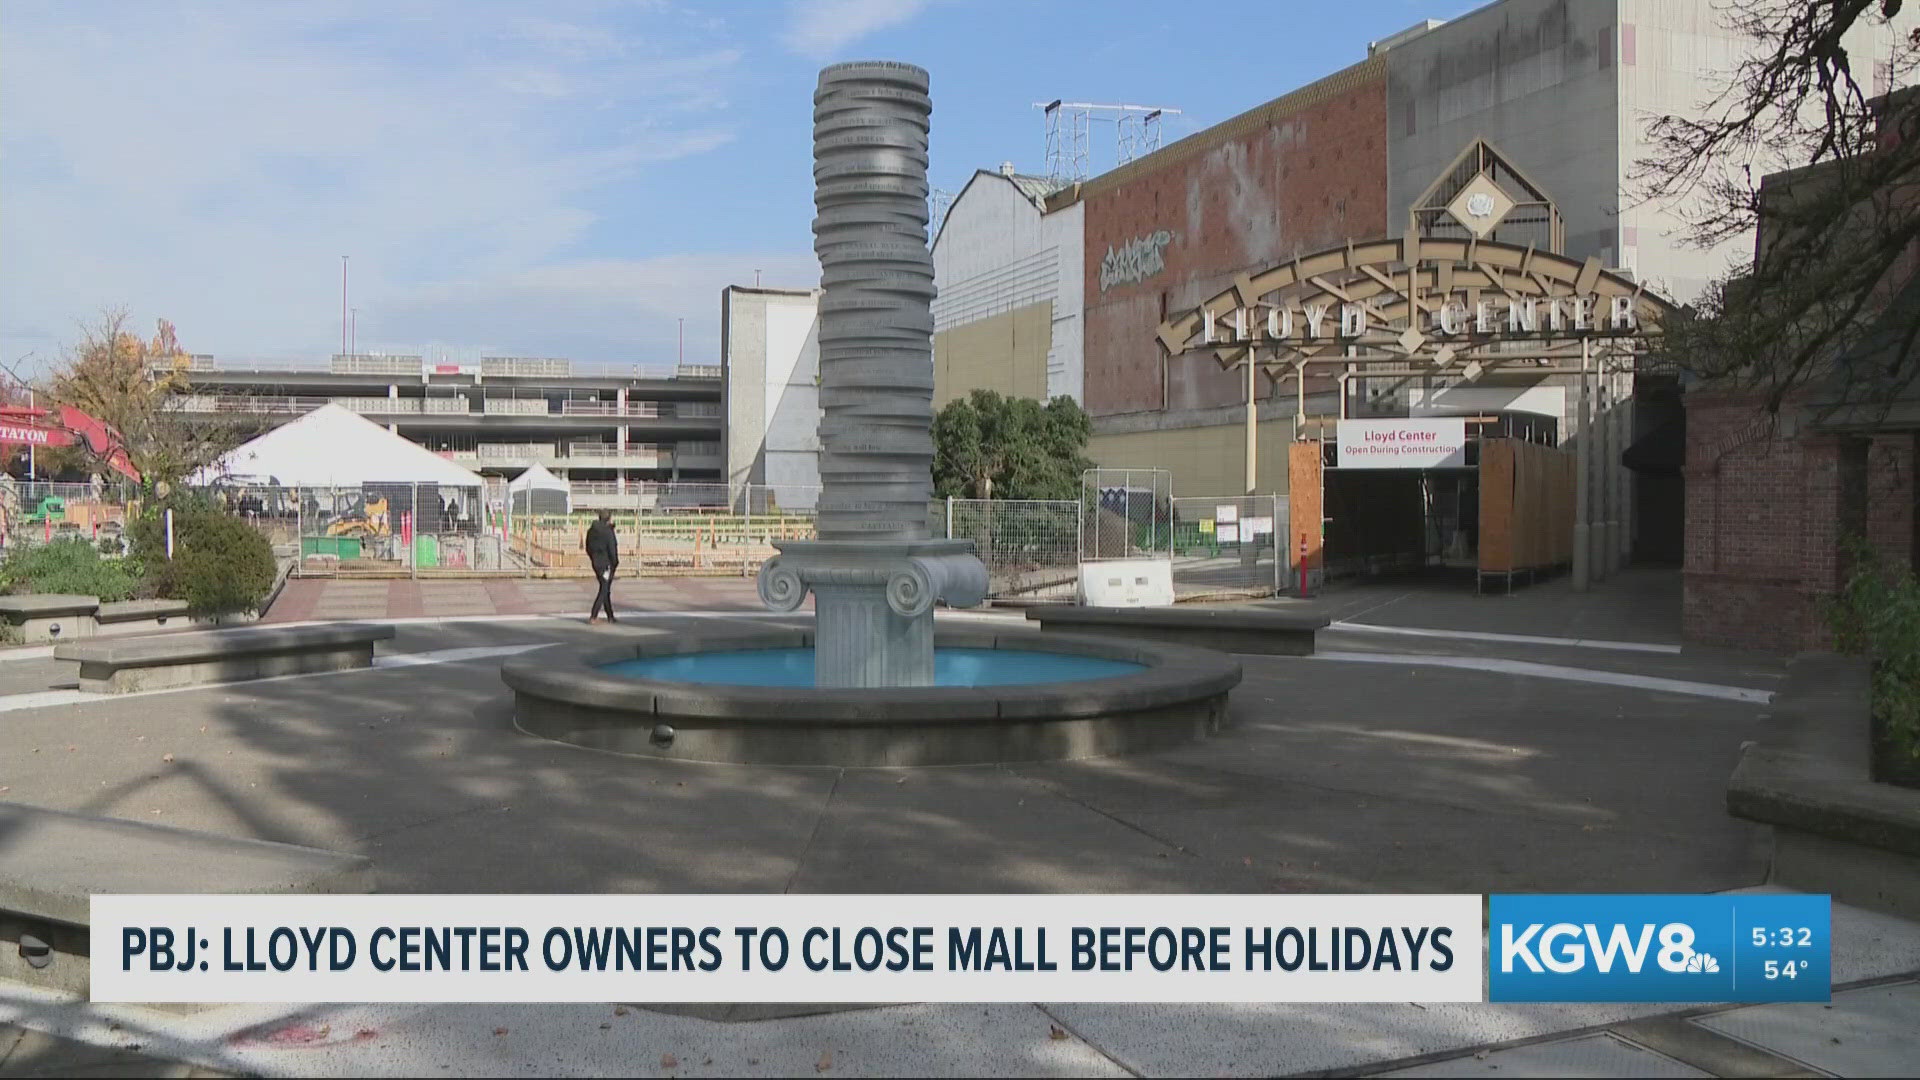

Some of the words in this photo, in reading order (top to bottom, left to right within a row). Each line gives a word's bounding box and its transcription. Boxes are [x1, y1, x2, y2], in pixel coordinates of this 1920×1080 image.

[1204, 303, 1367, 343] LLOYD
[1440, 296, 1638, 334] CENTER
[1364, 430, 1396, 443] Lloyd
[1398, 430, 1437, 441] Center
[1345, 445, 1369, 455] Open
[1370, 445, 1400, 455] During
[1401, 444, 1457, 454] Construction
